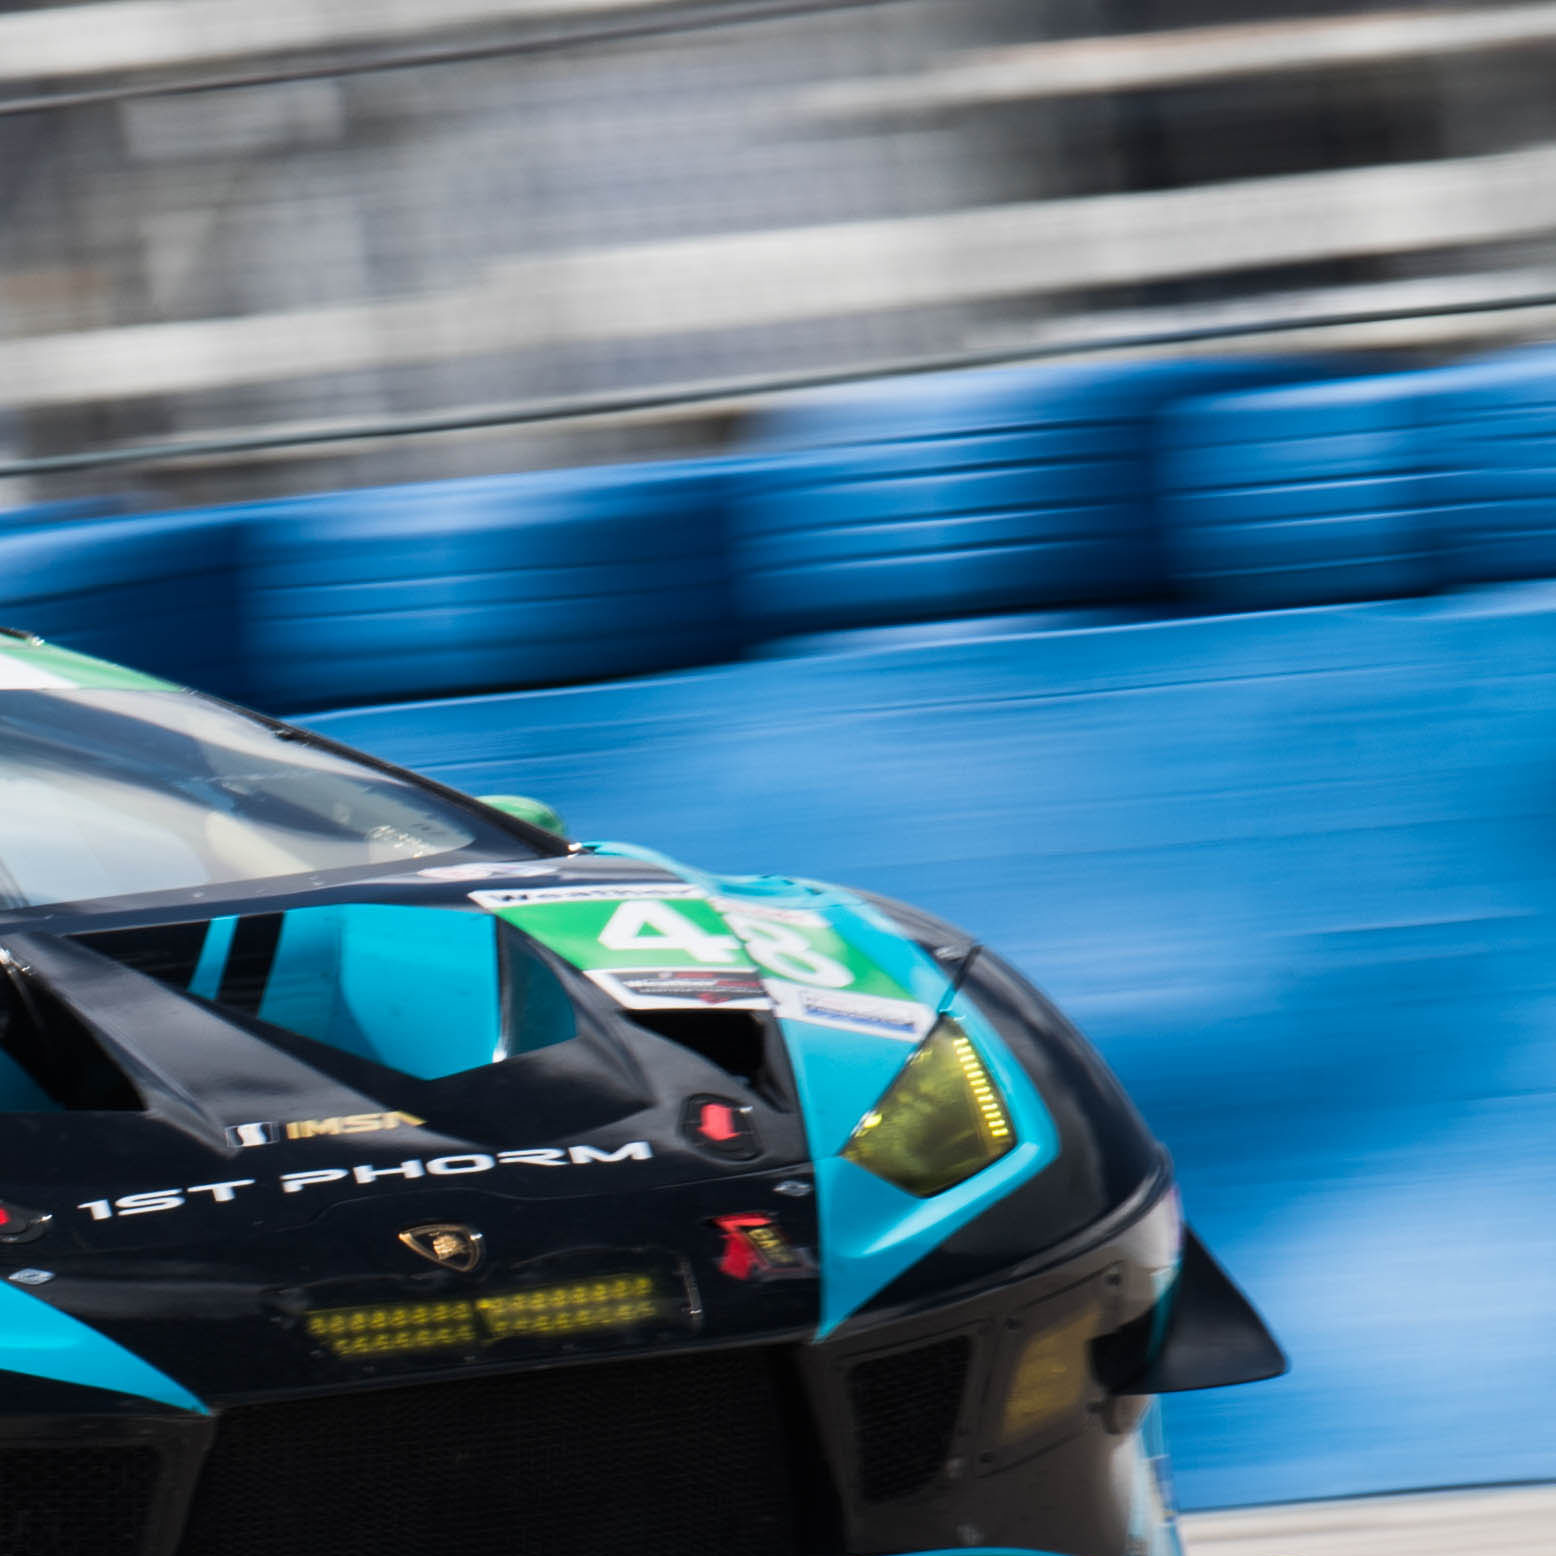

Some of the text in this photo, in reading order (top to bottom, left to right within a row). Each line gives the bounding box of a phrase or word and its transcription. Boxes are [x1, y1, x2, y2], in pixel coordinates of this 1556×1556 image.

[596, 897, 857, 990] 48
[76, 1140, 655, 1221] 1ST PHORM
